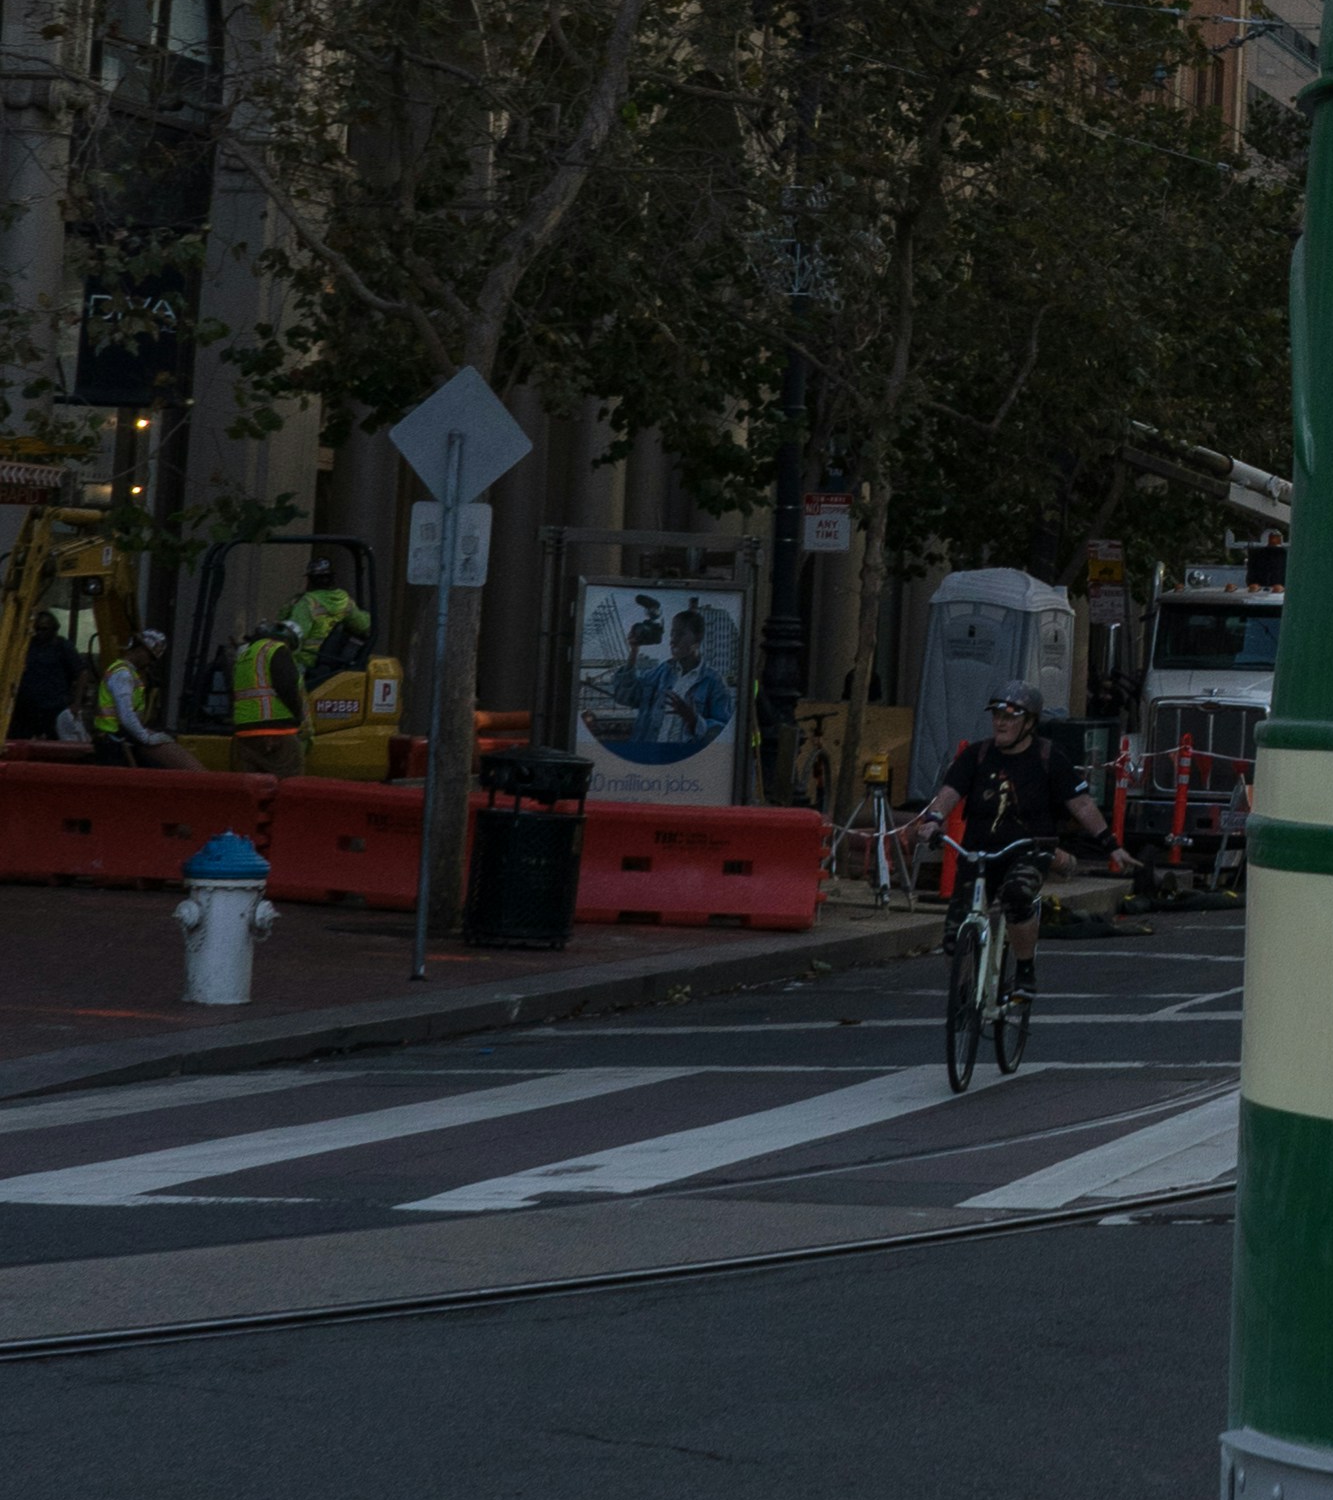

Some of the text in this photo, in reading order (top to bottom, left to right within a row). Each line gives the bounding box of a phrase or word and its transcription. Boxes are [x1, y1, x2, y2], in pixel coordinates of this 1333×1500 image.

[817, 519, 838, 528] ANY
[816, 530, 838, 539] TIME
[382, 683, 391, 702] P
[607, 773, 661, 792] million
[662, 773, 704, 796] jobs.
